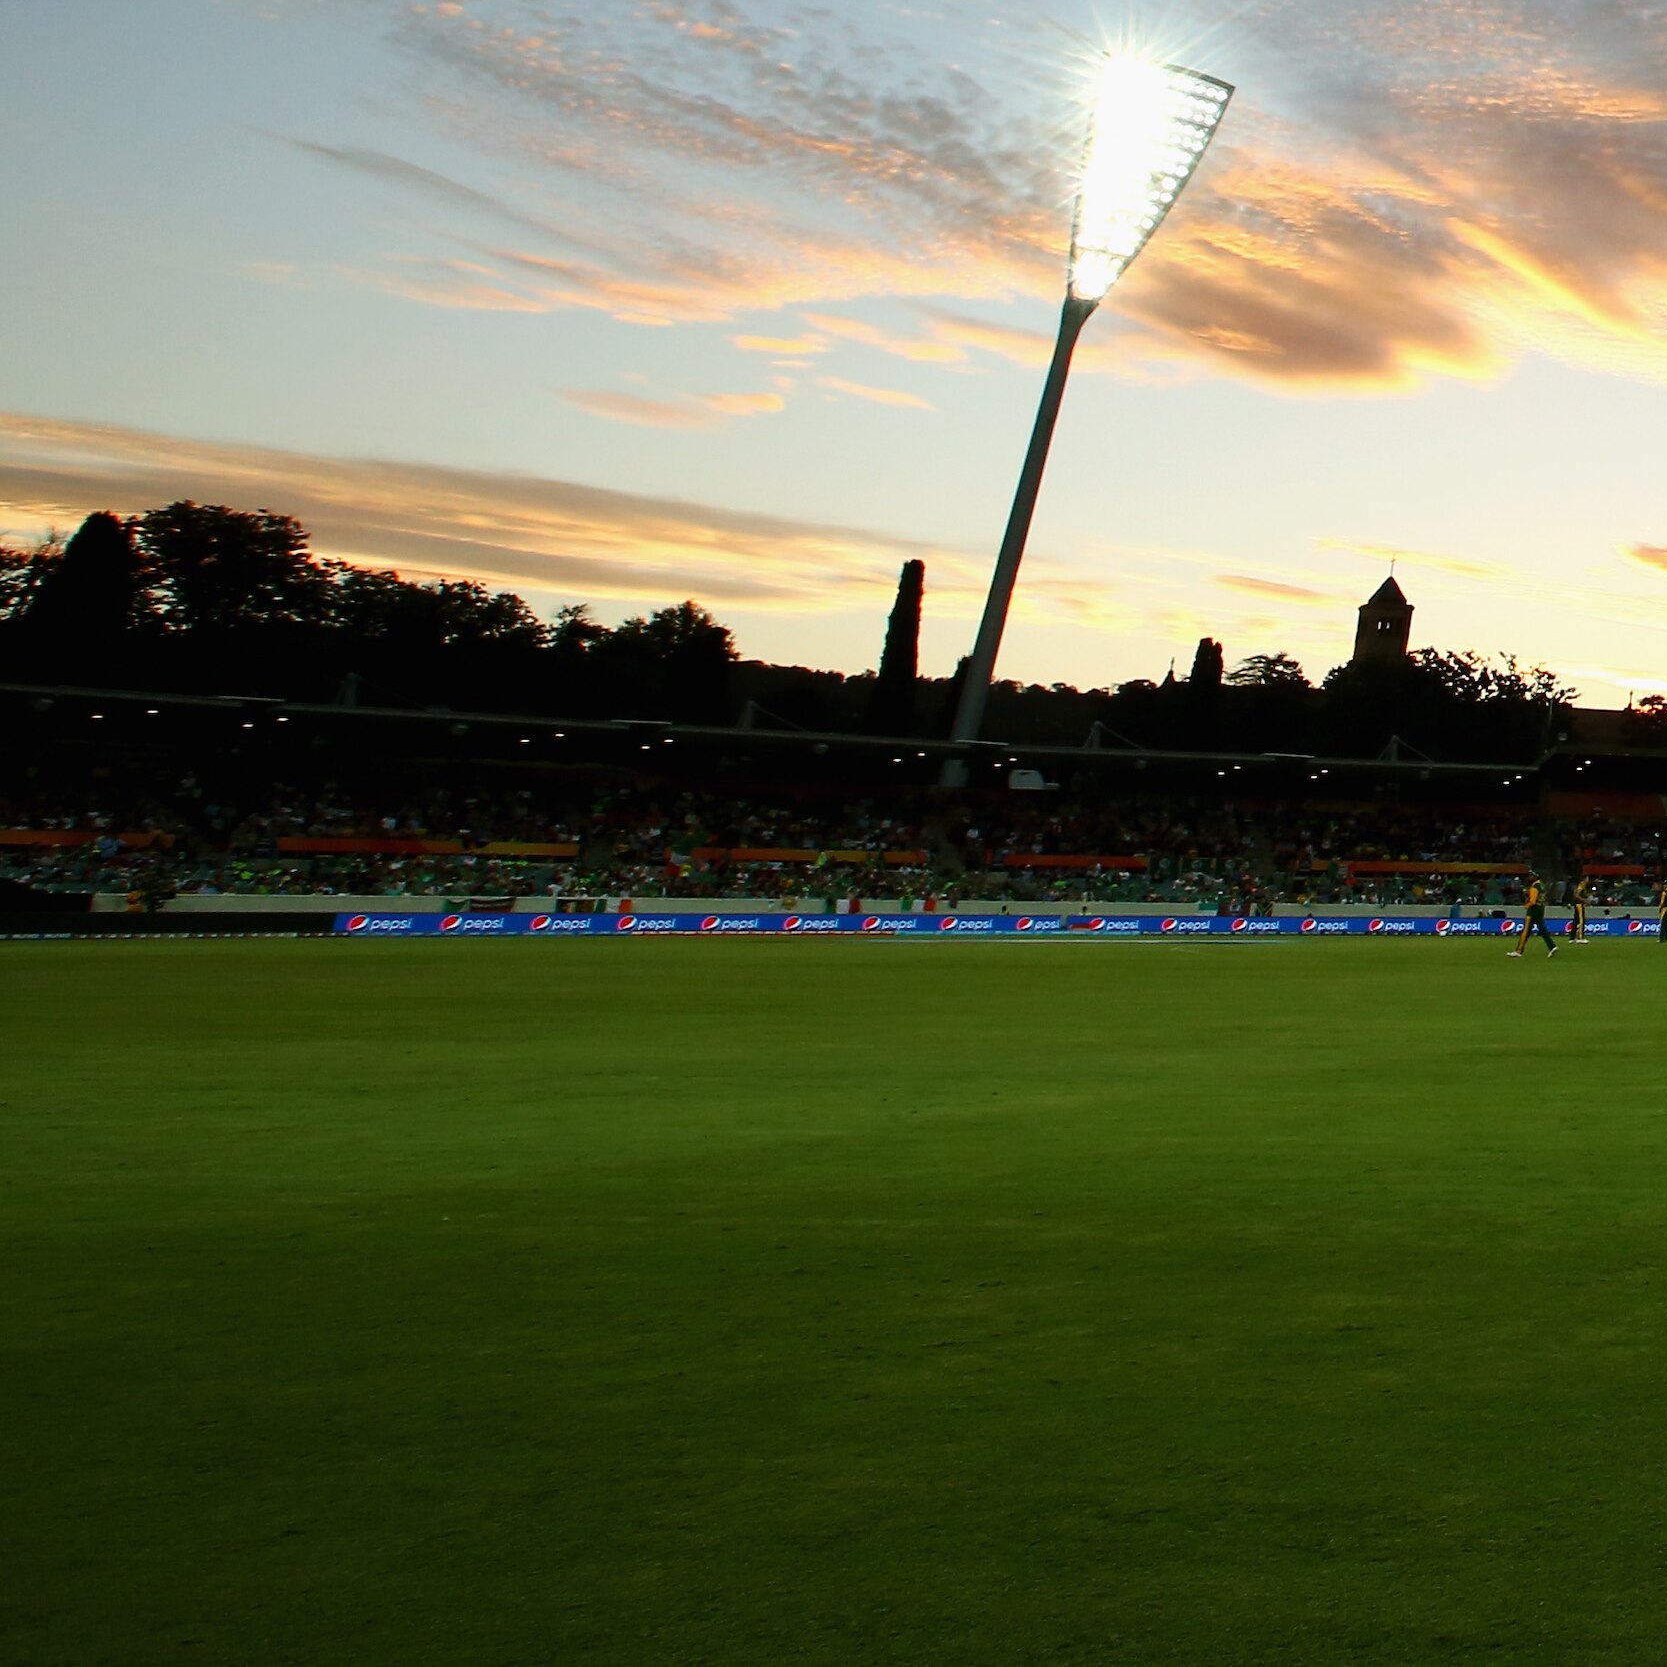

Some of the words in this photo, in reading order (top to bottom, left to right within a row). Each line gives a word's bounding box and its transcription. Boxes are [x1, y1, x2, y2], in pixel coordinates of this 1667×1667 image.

[369, 918, 413, 931] pepsi
[461, 918, 504, 931] pepsi
[551, 918, 592, 931] pepsi
[637, 918, 676, 931] pepsi
[720, 918, 759, 930] pepsi
[802, 919, 839, 930] pepsi
[881, 919, 917, 931] pepsi
[958, 919, 994, 931] pepsi
[1105, 920, 1139, 931] pepsi
[1178, 920, 1210, 931] pepsi
[1248, 921, 1280, 931] pepsi
[1317, 921, 1349, 931] pepsi
[1385, 921, 1416, 932] pepsi
[1450, 922, 1481, 932] pepsi
